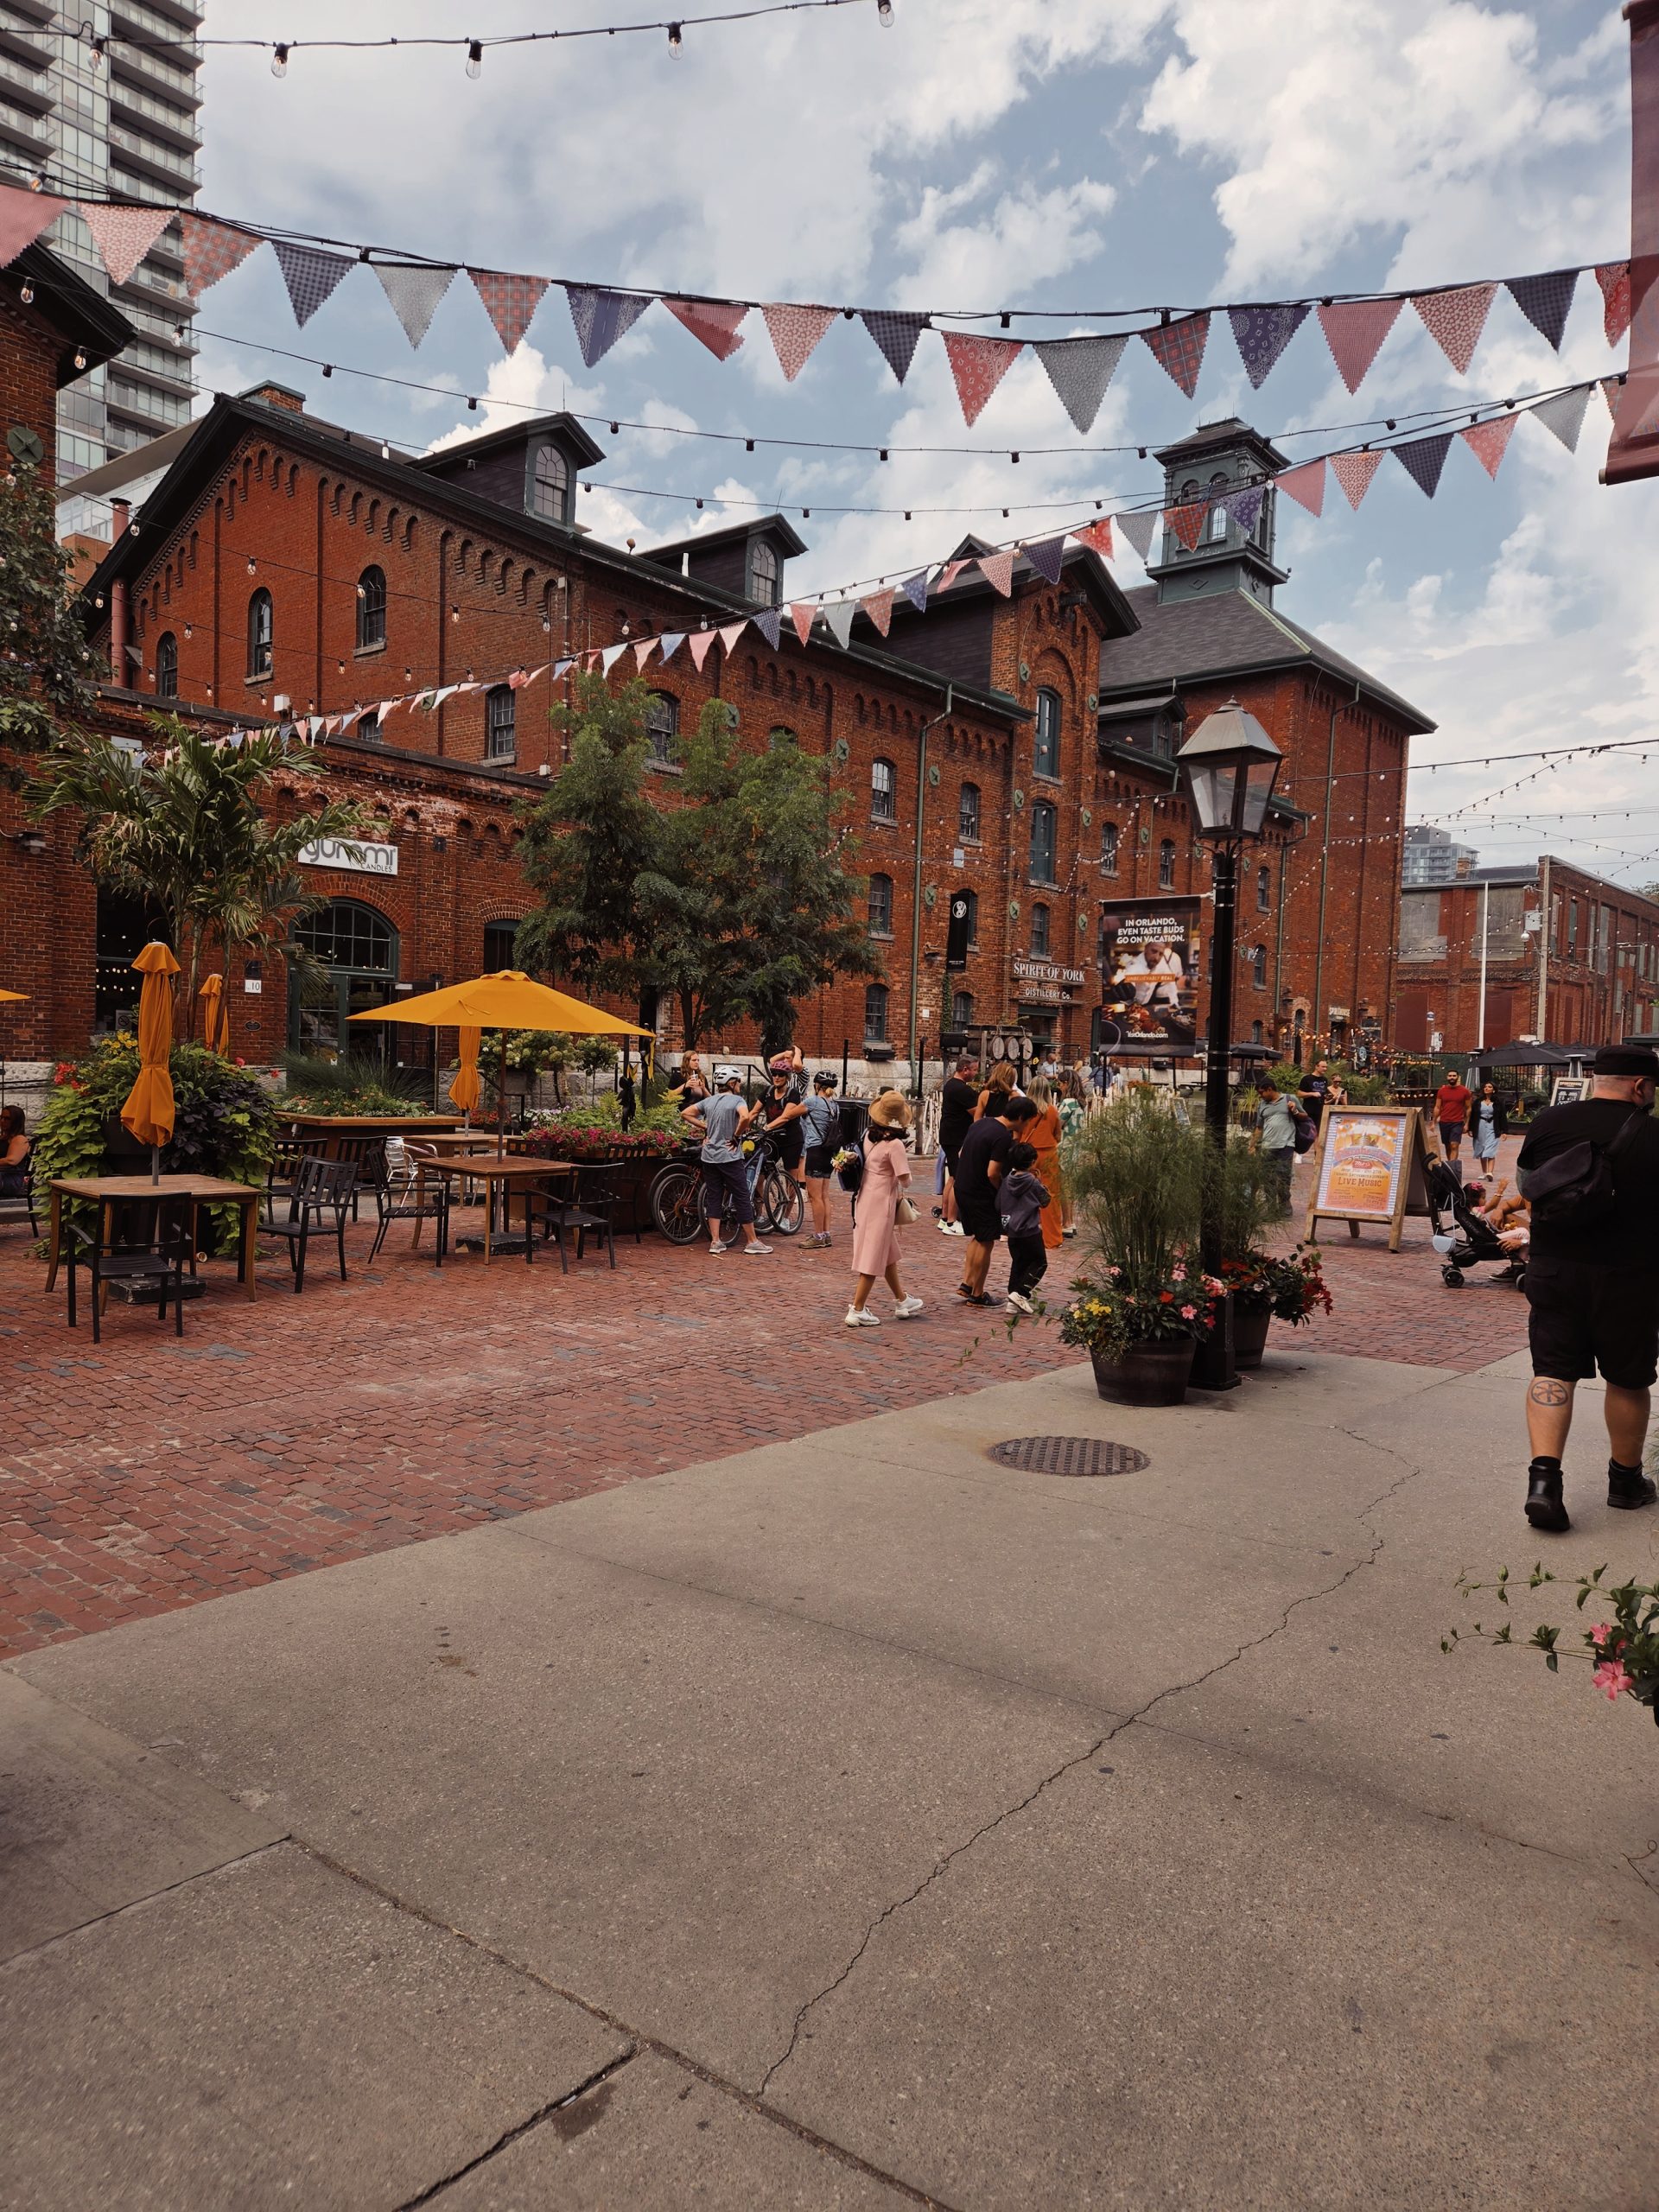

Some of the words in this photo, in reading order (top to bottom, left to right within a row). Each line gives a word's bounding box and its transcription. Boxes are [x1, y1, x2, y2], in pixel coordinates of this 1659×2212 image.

[1135, 918, 1177, 926] ORLANDO,
[1117, 927, 1139, 936] EVEN
[1140, 926, 1162, 935] TASTE
[1163, 925, 1185, 934] BUDS
[1116, 936, 1129, 944] GO
[1143, 934, 1185, 943] VACATION.
[1014, 962, 1045, 977] SPIRIT
[1047, 967, 1060, 979] OF
[1062, 968, 1085, 982] YORK
[1026, 988, 1060, 999] DISTILLERY
[1338, 1177, 1357, 1185] LIVE
[1357, 1178, 1382, 1187] MUSIC
